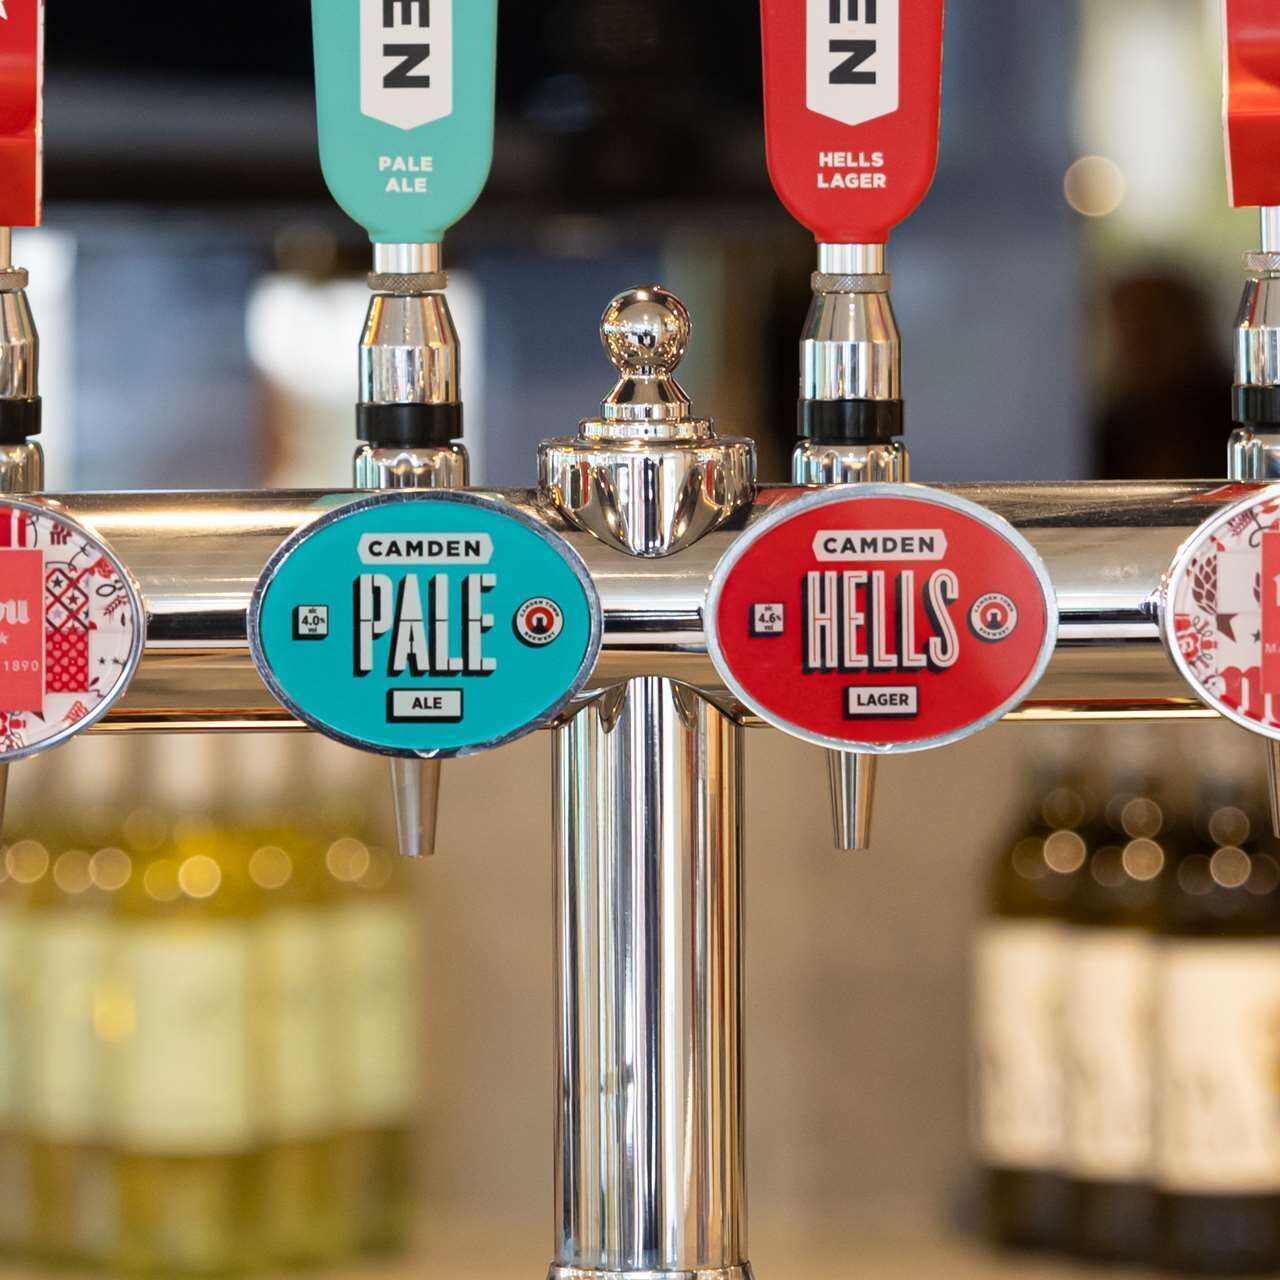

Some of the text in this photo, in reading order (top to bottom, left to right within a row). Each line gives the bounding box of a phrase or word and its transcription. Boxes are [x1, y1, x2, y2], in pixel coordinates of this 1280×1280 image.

[378, 156, 433, 173] PALE
[818, 151, 885, 168] HELLS
[385, 176, 428, 193] ALE
[816, 173, 887, 190] LAGER
[367, 540, 482, 557] CAMDEN
[822, 536, 935, 555] CAMDEN
[354, 573, 497, 676] PALE
[804, 568, 960, 672] HELLS
[2, 659, 40, 674] 1890
[411, 696, 443, 711] ALE
[856, 693, 910, 708] LAGER
